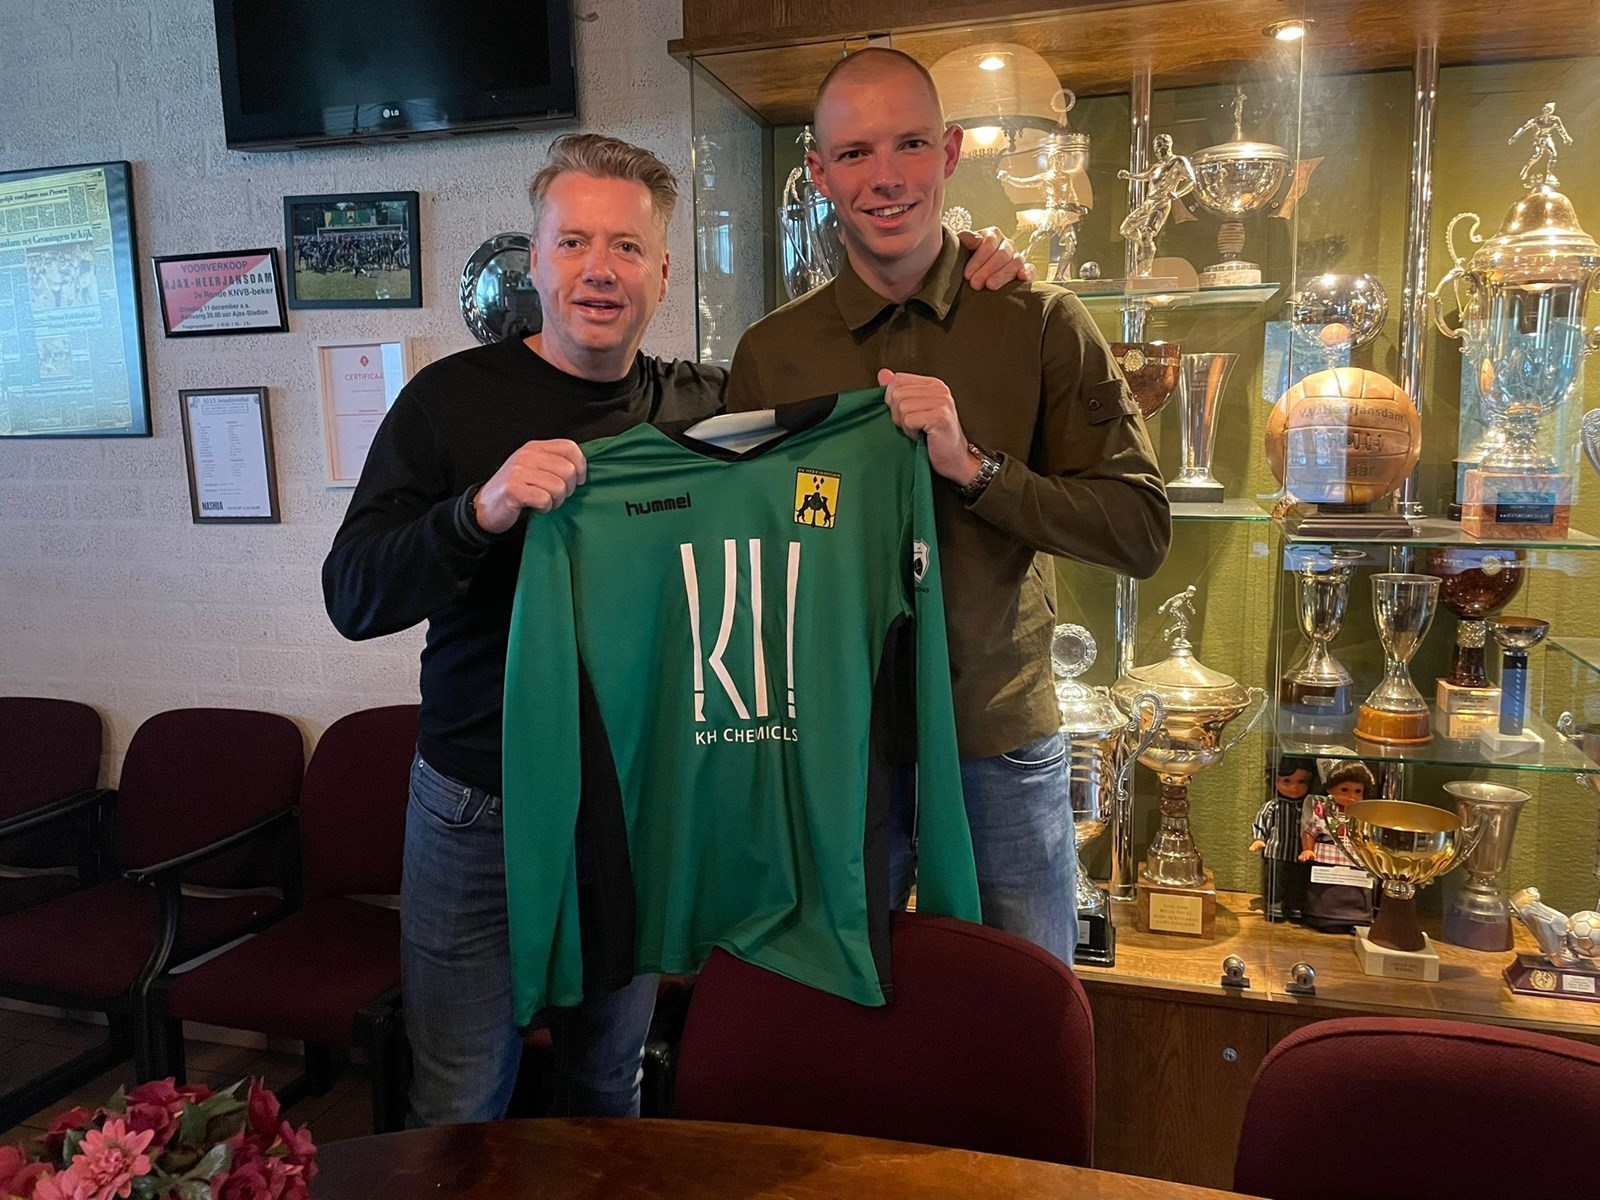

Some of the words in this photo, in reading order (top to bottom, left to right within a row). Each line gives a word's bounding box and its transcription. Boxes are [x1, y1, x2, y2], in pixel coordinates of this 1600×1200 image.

[391, 109, 400, 117] LG
[33, 234, 70, 244] Groningen
[181, 260, 248, 273] VOORVERKOOP
[228, 287, 273, 298] KNVB-beker
[211, 303, 239, 311] december
[232, 309, 269, 319] Ajax-Stadion
[345, 373, 384, 381] CERTIFICAA
[625, 492, 691, 517] hummel
[695, 729, 717, 745] KH
